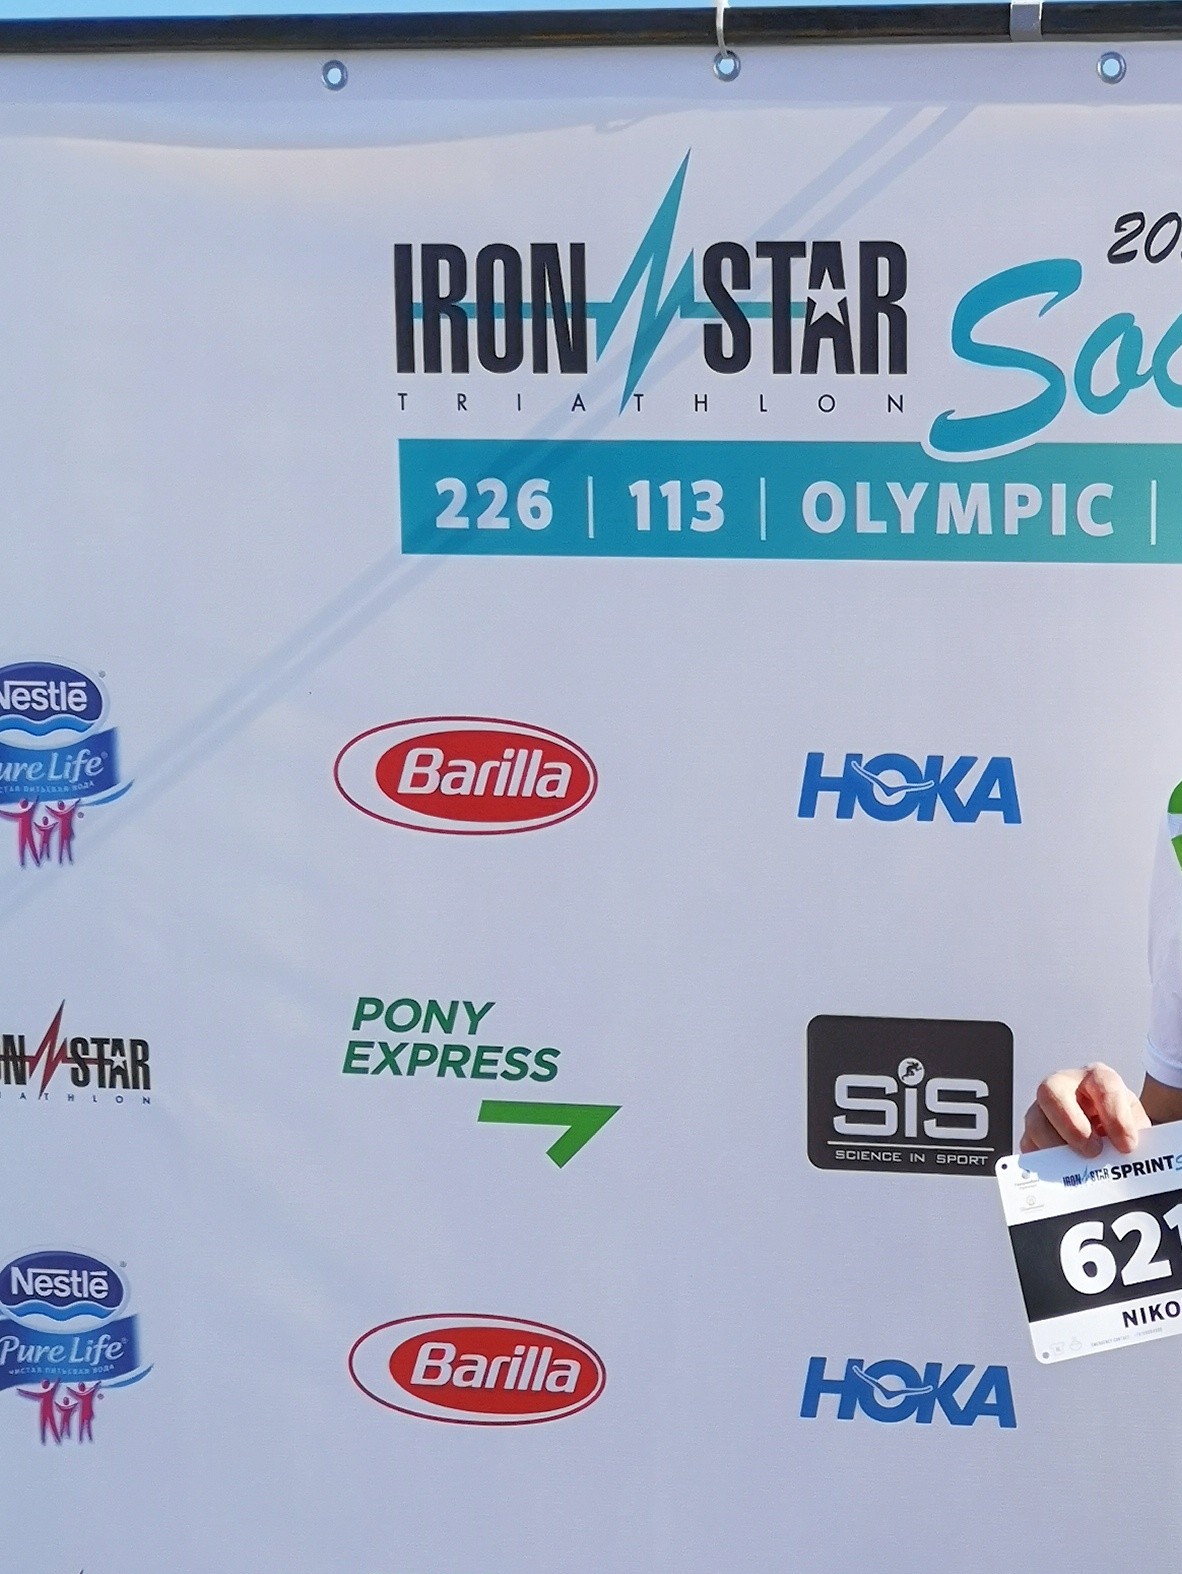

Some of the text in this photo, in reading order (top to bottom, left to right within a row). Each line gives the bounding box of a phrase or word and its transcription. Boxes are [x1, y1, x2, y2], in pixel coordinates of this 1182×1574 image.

[394, 240, 908, 375] IRON STAR
[397, 392, 904, 414] TRIATHLON
[435, 477, 1114, 538] 226 113 OLYMPIC
[0, 748, 104, 784] ure Life
[396, 747, 572, 799] Barilla
[797, 752, 1022, 825] HOKA
[352, 997, 496, 1036] PONY
[70, 1036, 151, 1090] STAR
[341, 1041, 561, 1083] EXPRESS
[0, 1091, 151, 1105] ATHLON
[835, 1149, 989, 1166] SCIENCE IN SPORT
[1111, 1155, 1174, 1180] SPRINT
[0, 1333, 124, 1367] Pure Life
[410, 1341, 583, 1394] Barilla
[799, 1356, 1017, 1428] HOKA
